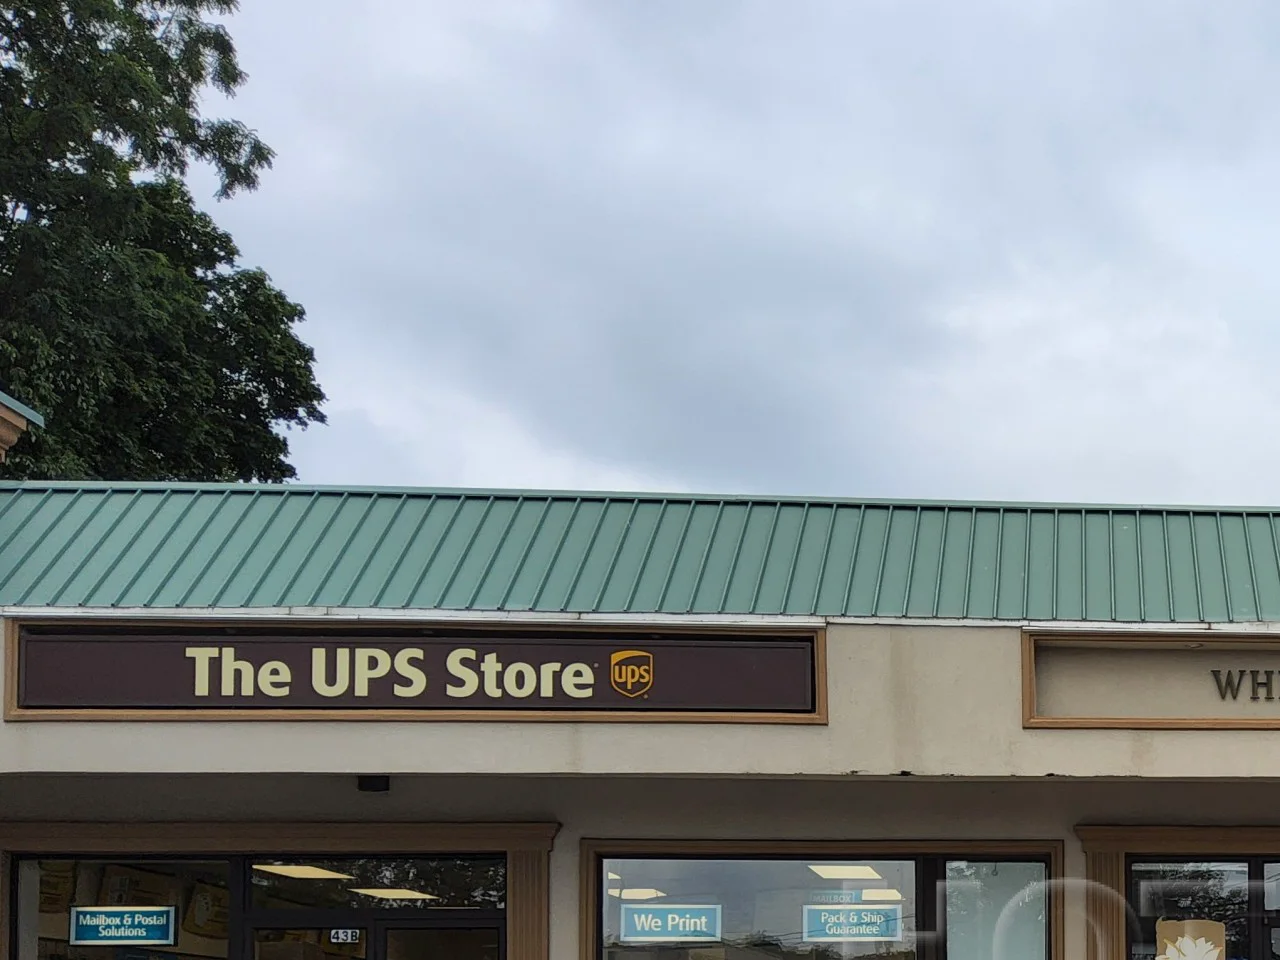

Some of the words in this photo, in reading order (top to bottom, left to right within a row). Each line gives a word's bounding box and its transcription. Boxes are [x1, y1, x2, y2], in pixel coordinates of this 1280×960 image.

[185, 647, 292, 697] The
[311, 647, 427, 698] UPS
[445, 648, 595, 698] Store
[613, 664, 651, 686] ups
[79, 914, 121, 926] Mailbox
[123, 914, 132, 926] &
[134, 914, 167, 926] Postal
[634, 914, 662, 931] We
[667, 913, 708, 932] Print
[821, 911, 846, 923] Pack
[849, 912, 859, 923] &
[860, 911, 884, 926] Ship
[98, 925, 147, 937] Solutions
[825, 923, 880, 935] Guarantee
